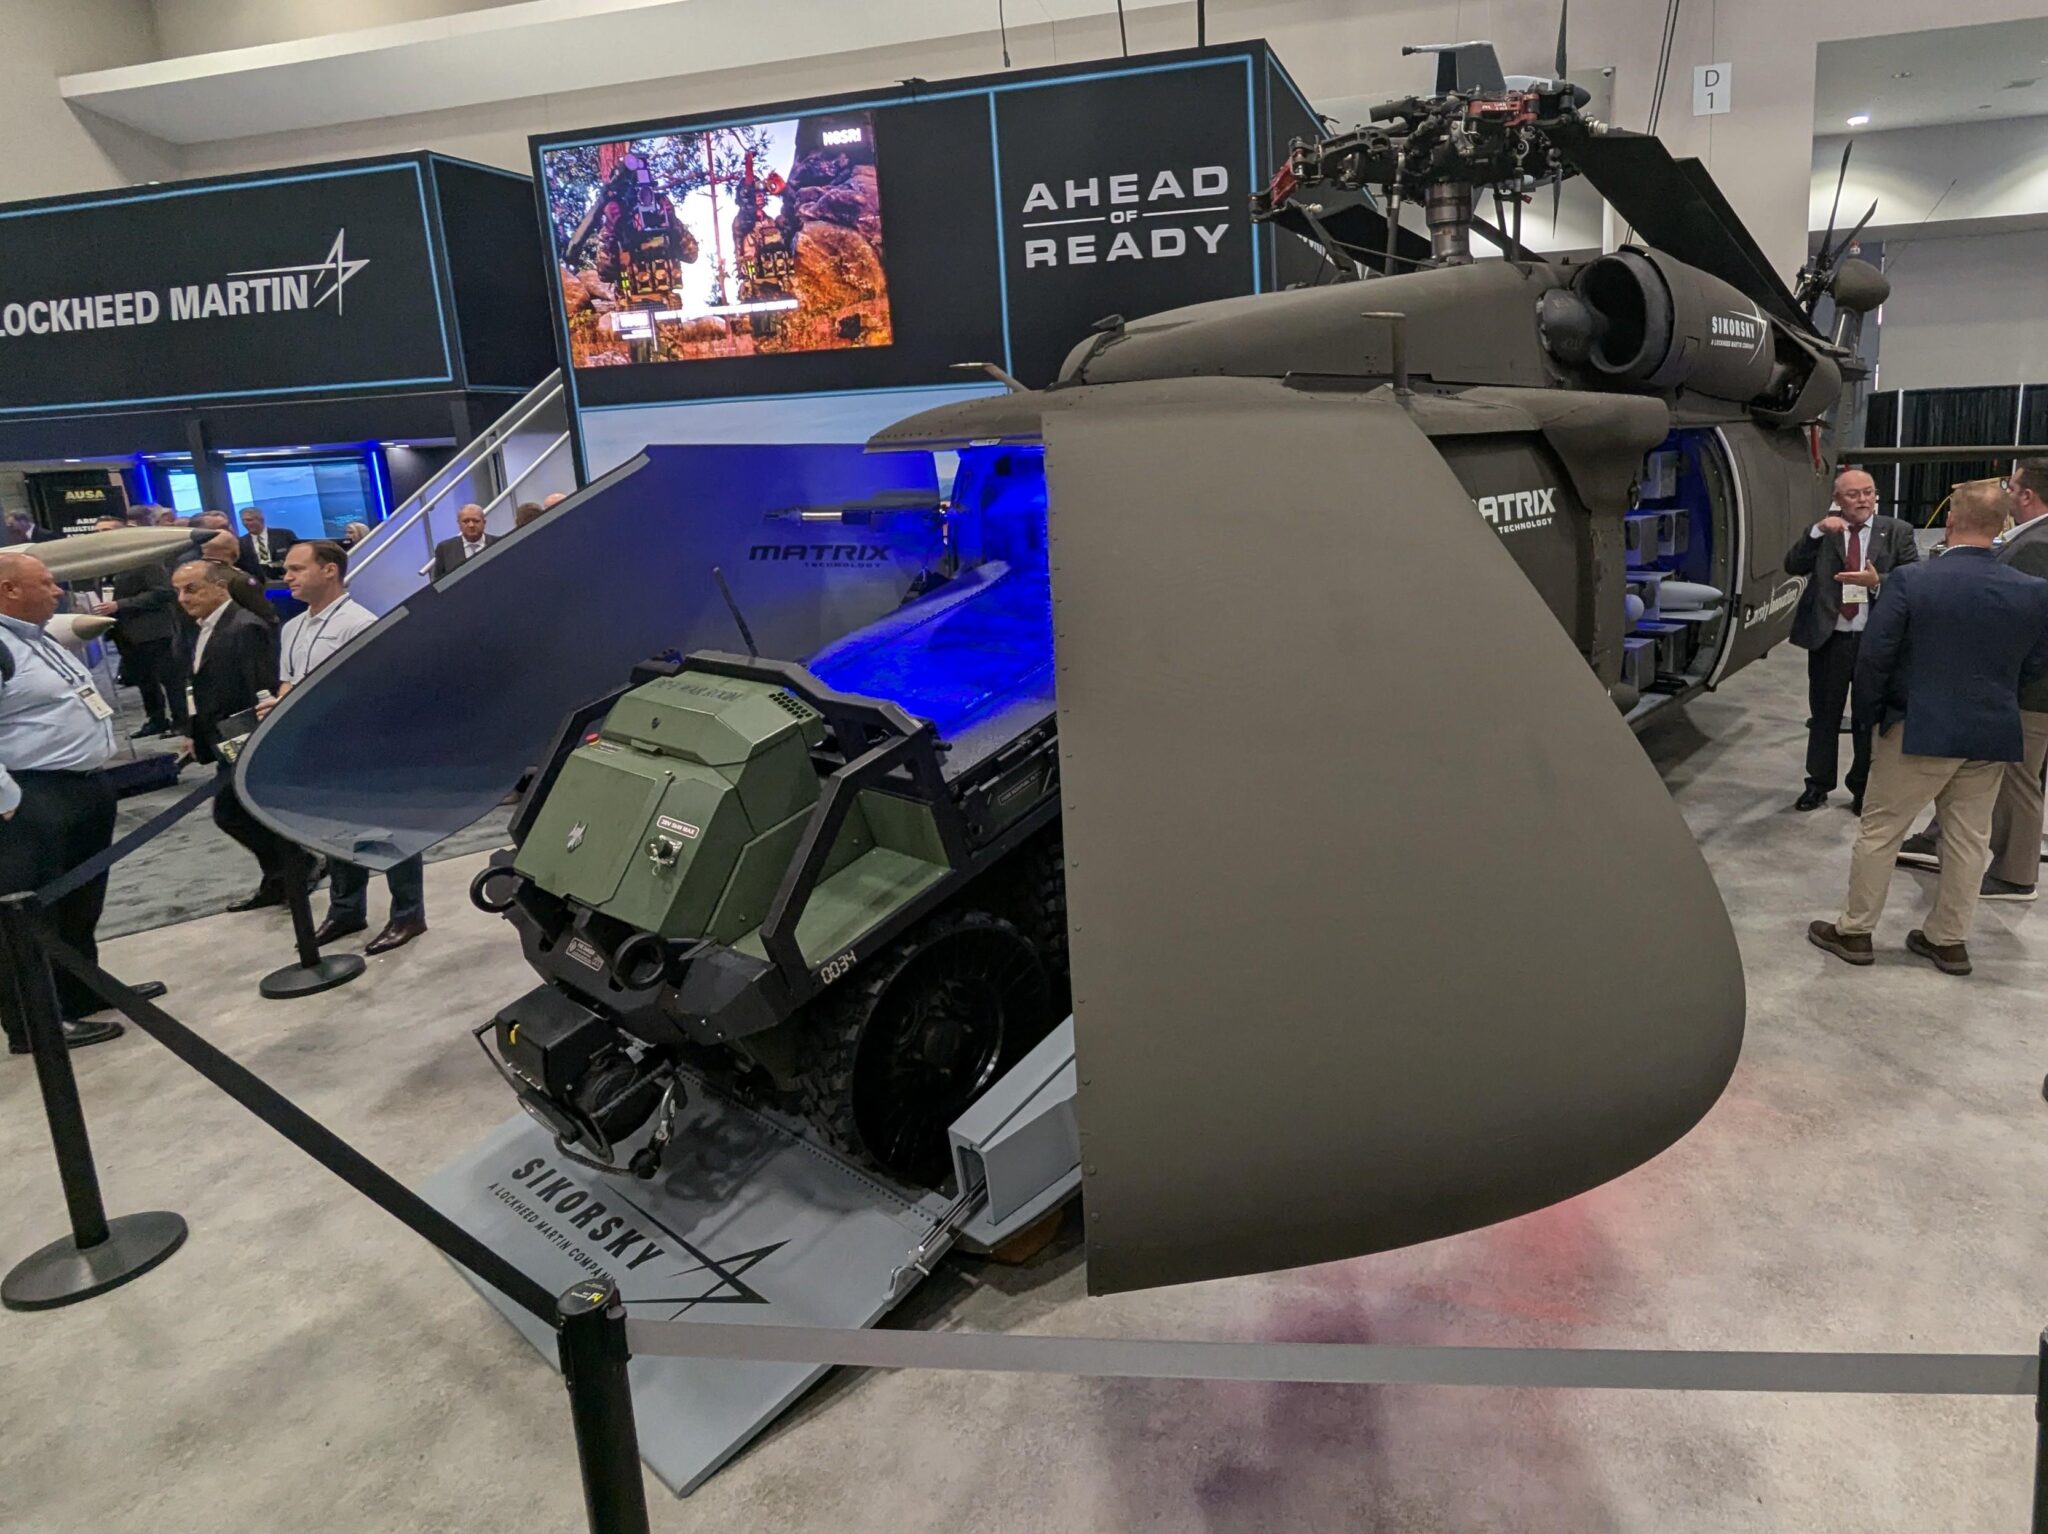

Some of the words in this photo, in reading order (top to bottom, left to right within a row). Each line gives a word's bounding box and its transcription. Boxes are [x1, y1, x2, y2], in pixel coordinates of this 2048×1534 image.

[1705, 69, 1720, 87] D
[1706, 91, 1714, 109] 1
[1022, 166, 1229, 213] AHEAD
[1110, 210, 1138, 224] OF
[1025, 224, 1229, 268] READY
[0, 290, 160, 337] OCKHEED
[169, 274, 309, 321] MARTIN
[1711, 315, 1755, 339] SIKORSKY
[65, 489, 105, 500] AUSA
[1472, 488, 1556, 523] ATRIX
[1498, 517, 1553, 534] TECHNOLOGY
[749, 544, 890, 561] MATRIX
[821, 949, 857, 984] 0034
[488, 1183, 499, 1191] A
[494, 1187, 539, 1224] LOCKHEED
[535, 1221, 573, 1250] MARTIN
[511, 1158, 666, 1271] SIKORSKY
